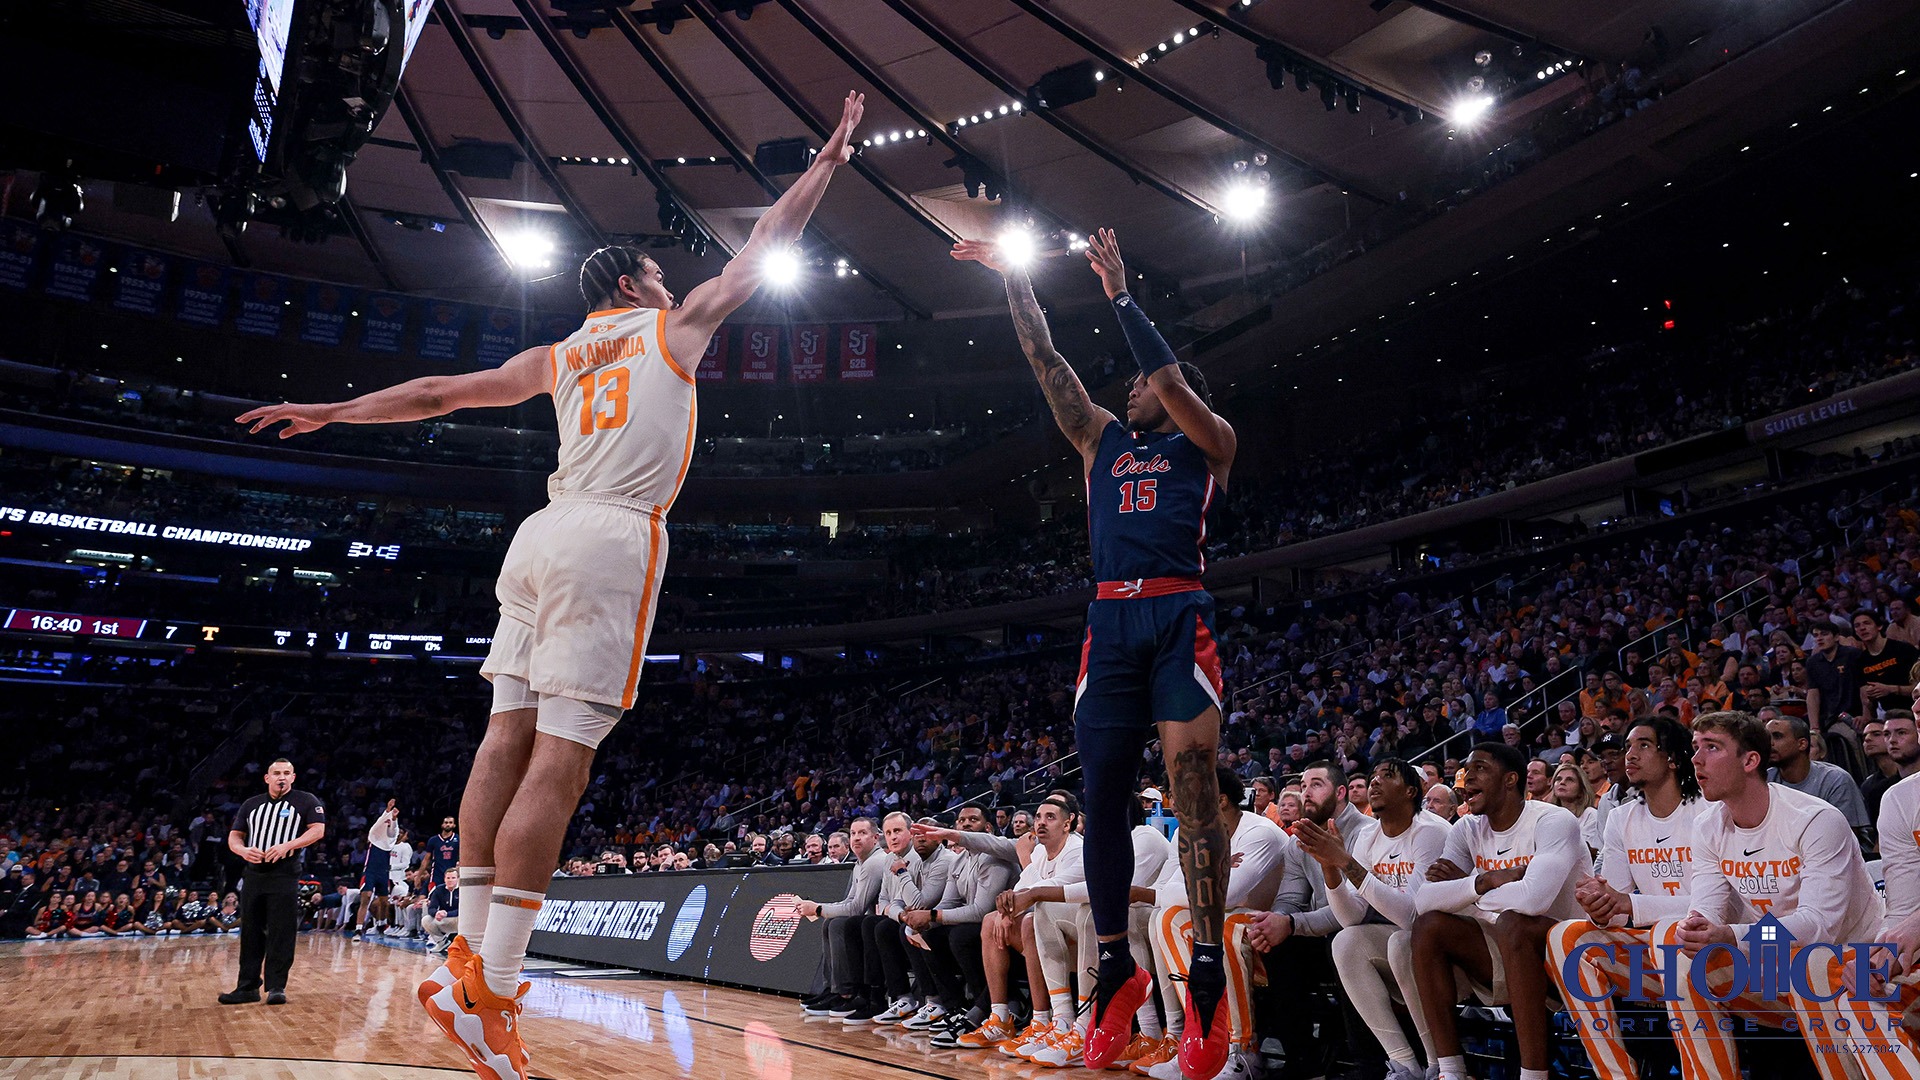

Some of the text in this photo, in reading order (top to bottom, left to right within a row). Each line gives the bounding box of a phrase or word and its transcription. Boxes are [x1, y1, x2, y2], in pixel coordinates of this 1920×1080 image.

[566, 336, 645, 371] NKAMHOUA
[577, 366, 630, 435] 13
[1764, 399, 1858, 436] SUITE LEVEL
[1112, 451, 1171, 477] Owls
[1119, 479, 1157, 513] 15
[28, 510, 158, 537] BASKETBALL
[162, 526, 312, 552] CHAMPIONSHIP
[31, 615, 120, 635] 16:40 1st
[165, 625, 178, 640] 7
[277, 636, 285, 645] 0
[307, 638, 314, 647] 4
[371, 640, 392, 650] 0/0
[1651, 860, 1684, 878] SOLE
[1739, 874, 1780, 894] SOLE
[559, 900, 666, 941] STUDENT-ATHLETES
